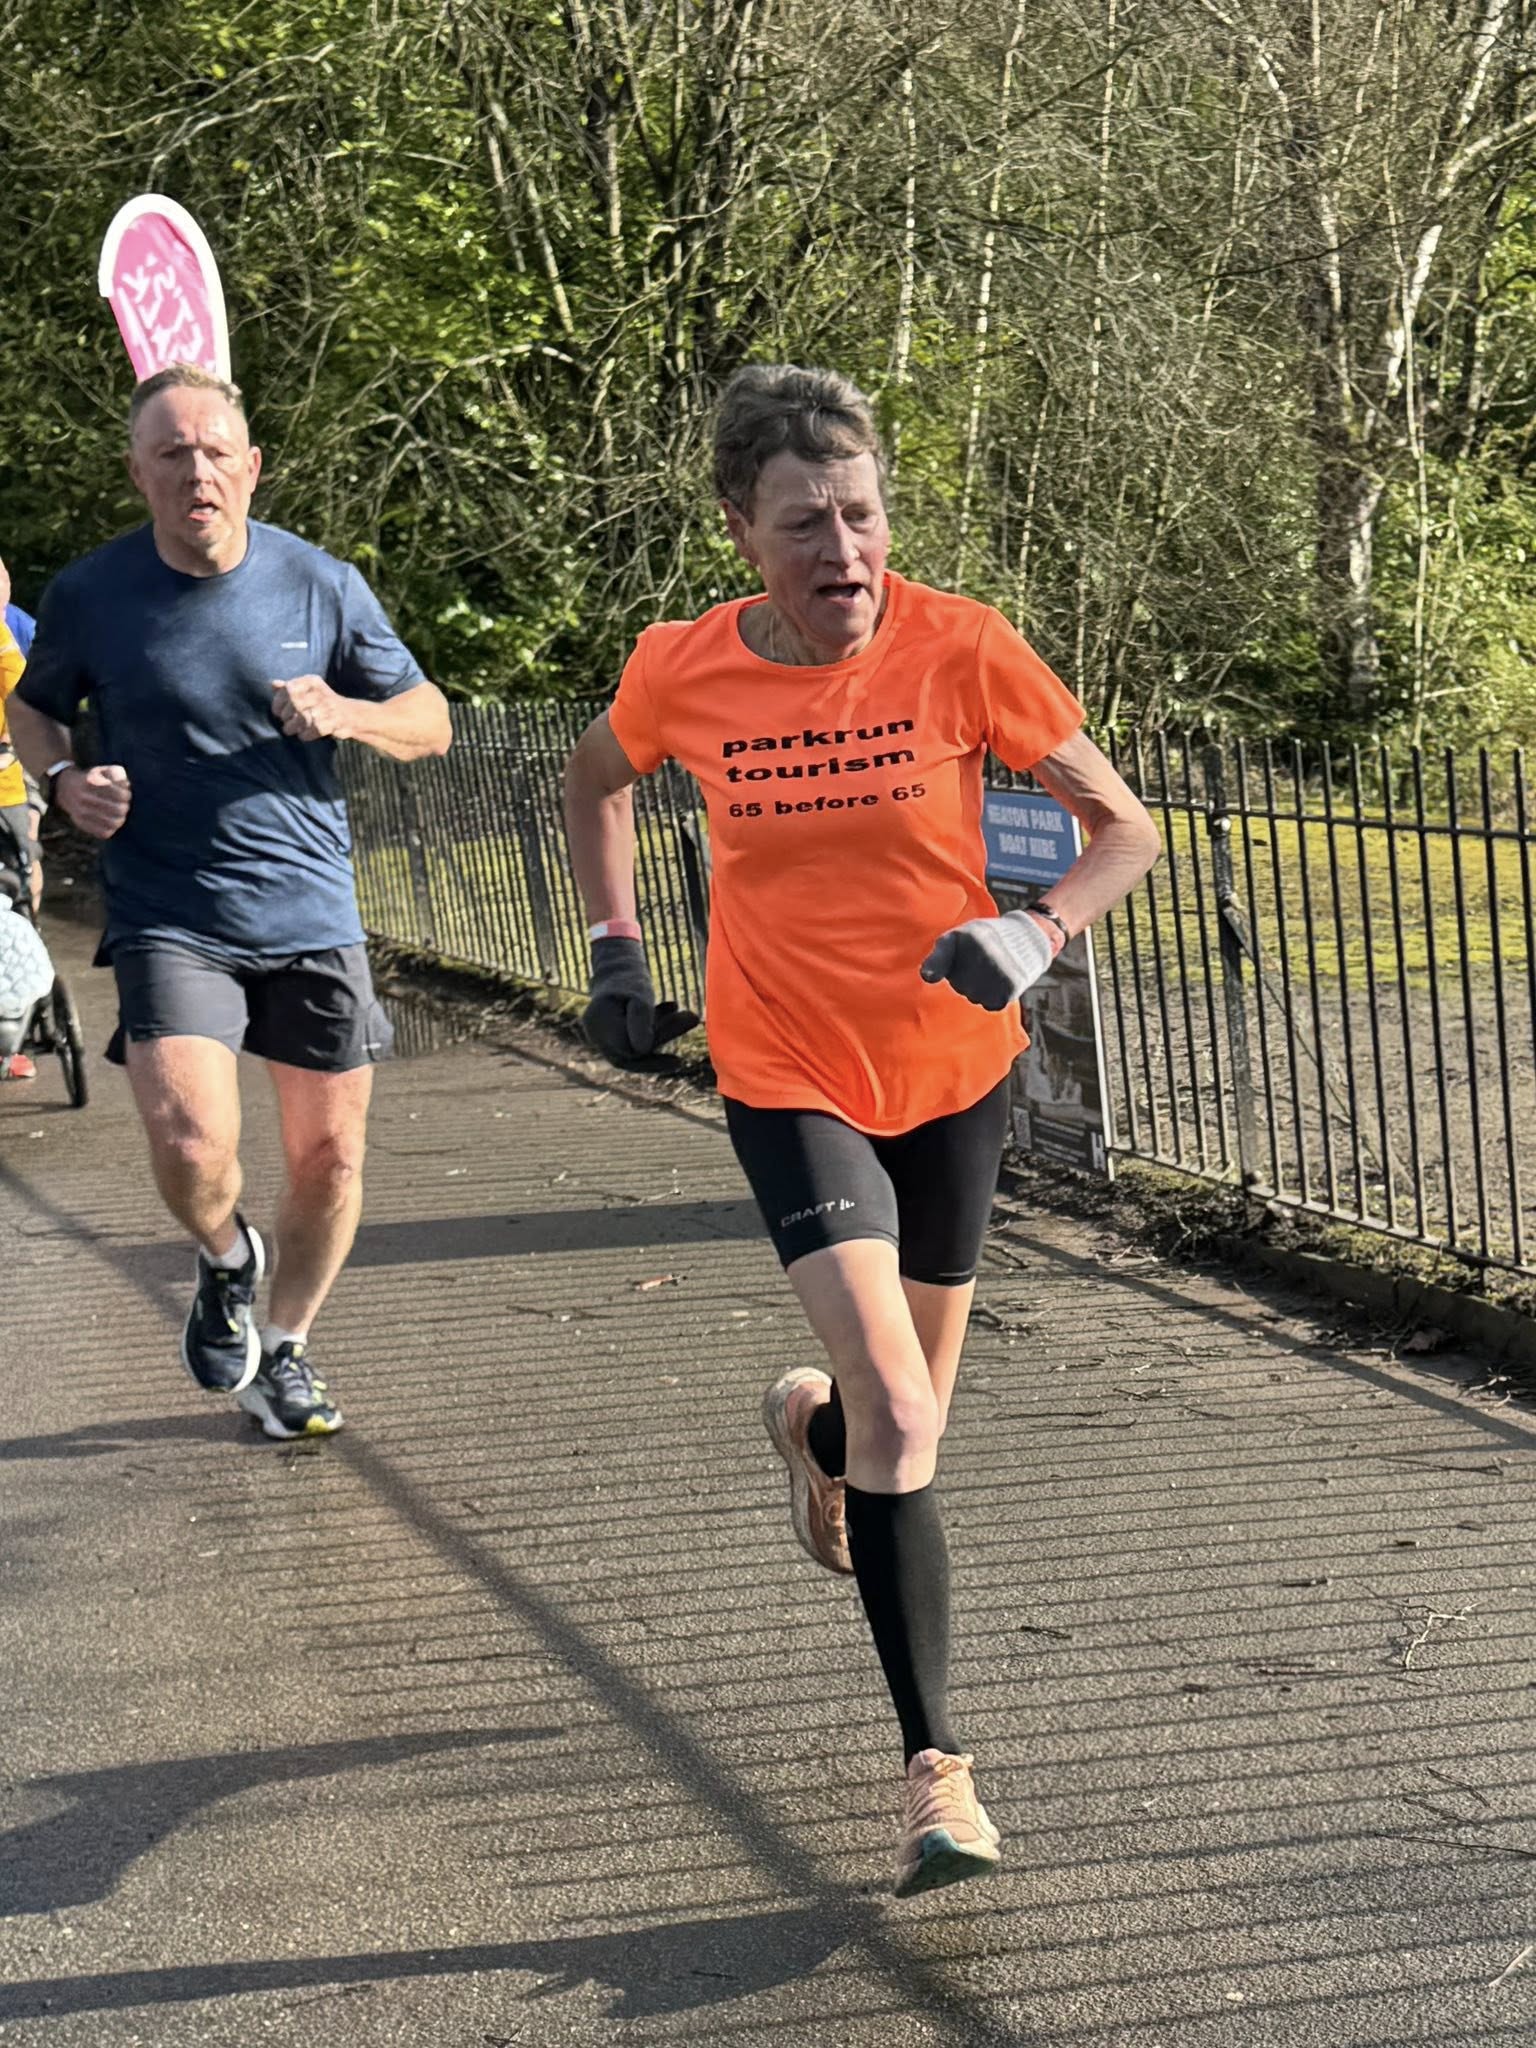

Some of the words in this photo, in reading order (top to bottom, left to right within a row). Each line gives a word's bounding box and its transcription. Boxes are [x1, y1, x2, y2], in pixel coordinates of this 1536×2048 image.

[722, 719, 914, 758] parkrun
[725, 748, 915, 783] tourism
[729, 802, 763, 818] 65
[775, 793, 879, 815] before
[892, 782, 926, 801] 65
[1030, 808, 1065, 833] PARK
[998, 832, 1028, 856] BOAT
[1029, 836, 1058, 860] HIRE
[780, 1200, 836, 1228] CRAFT
